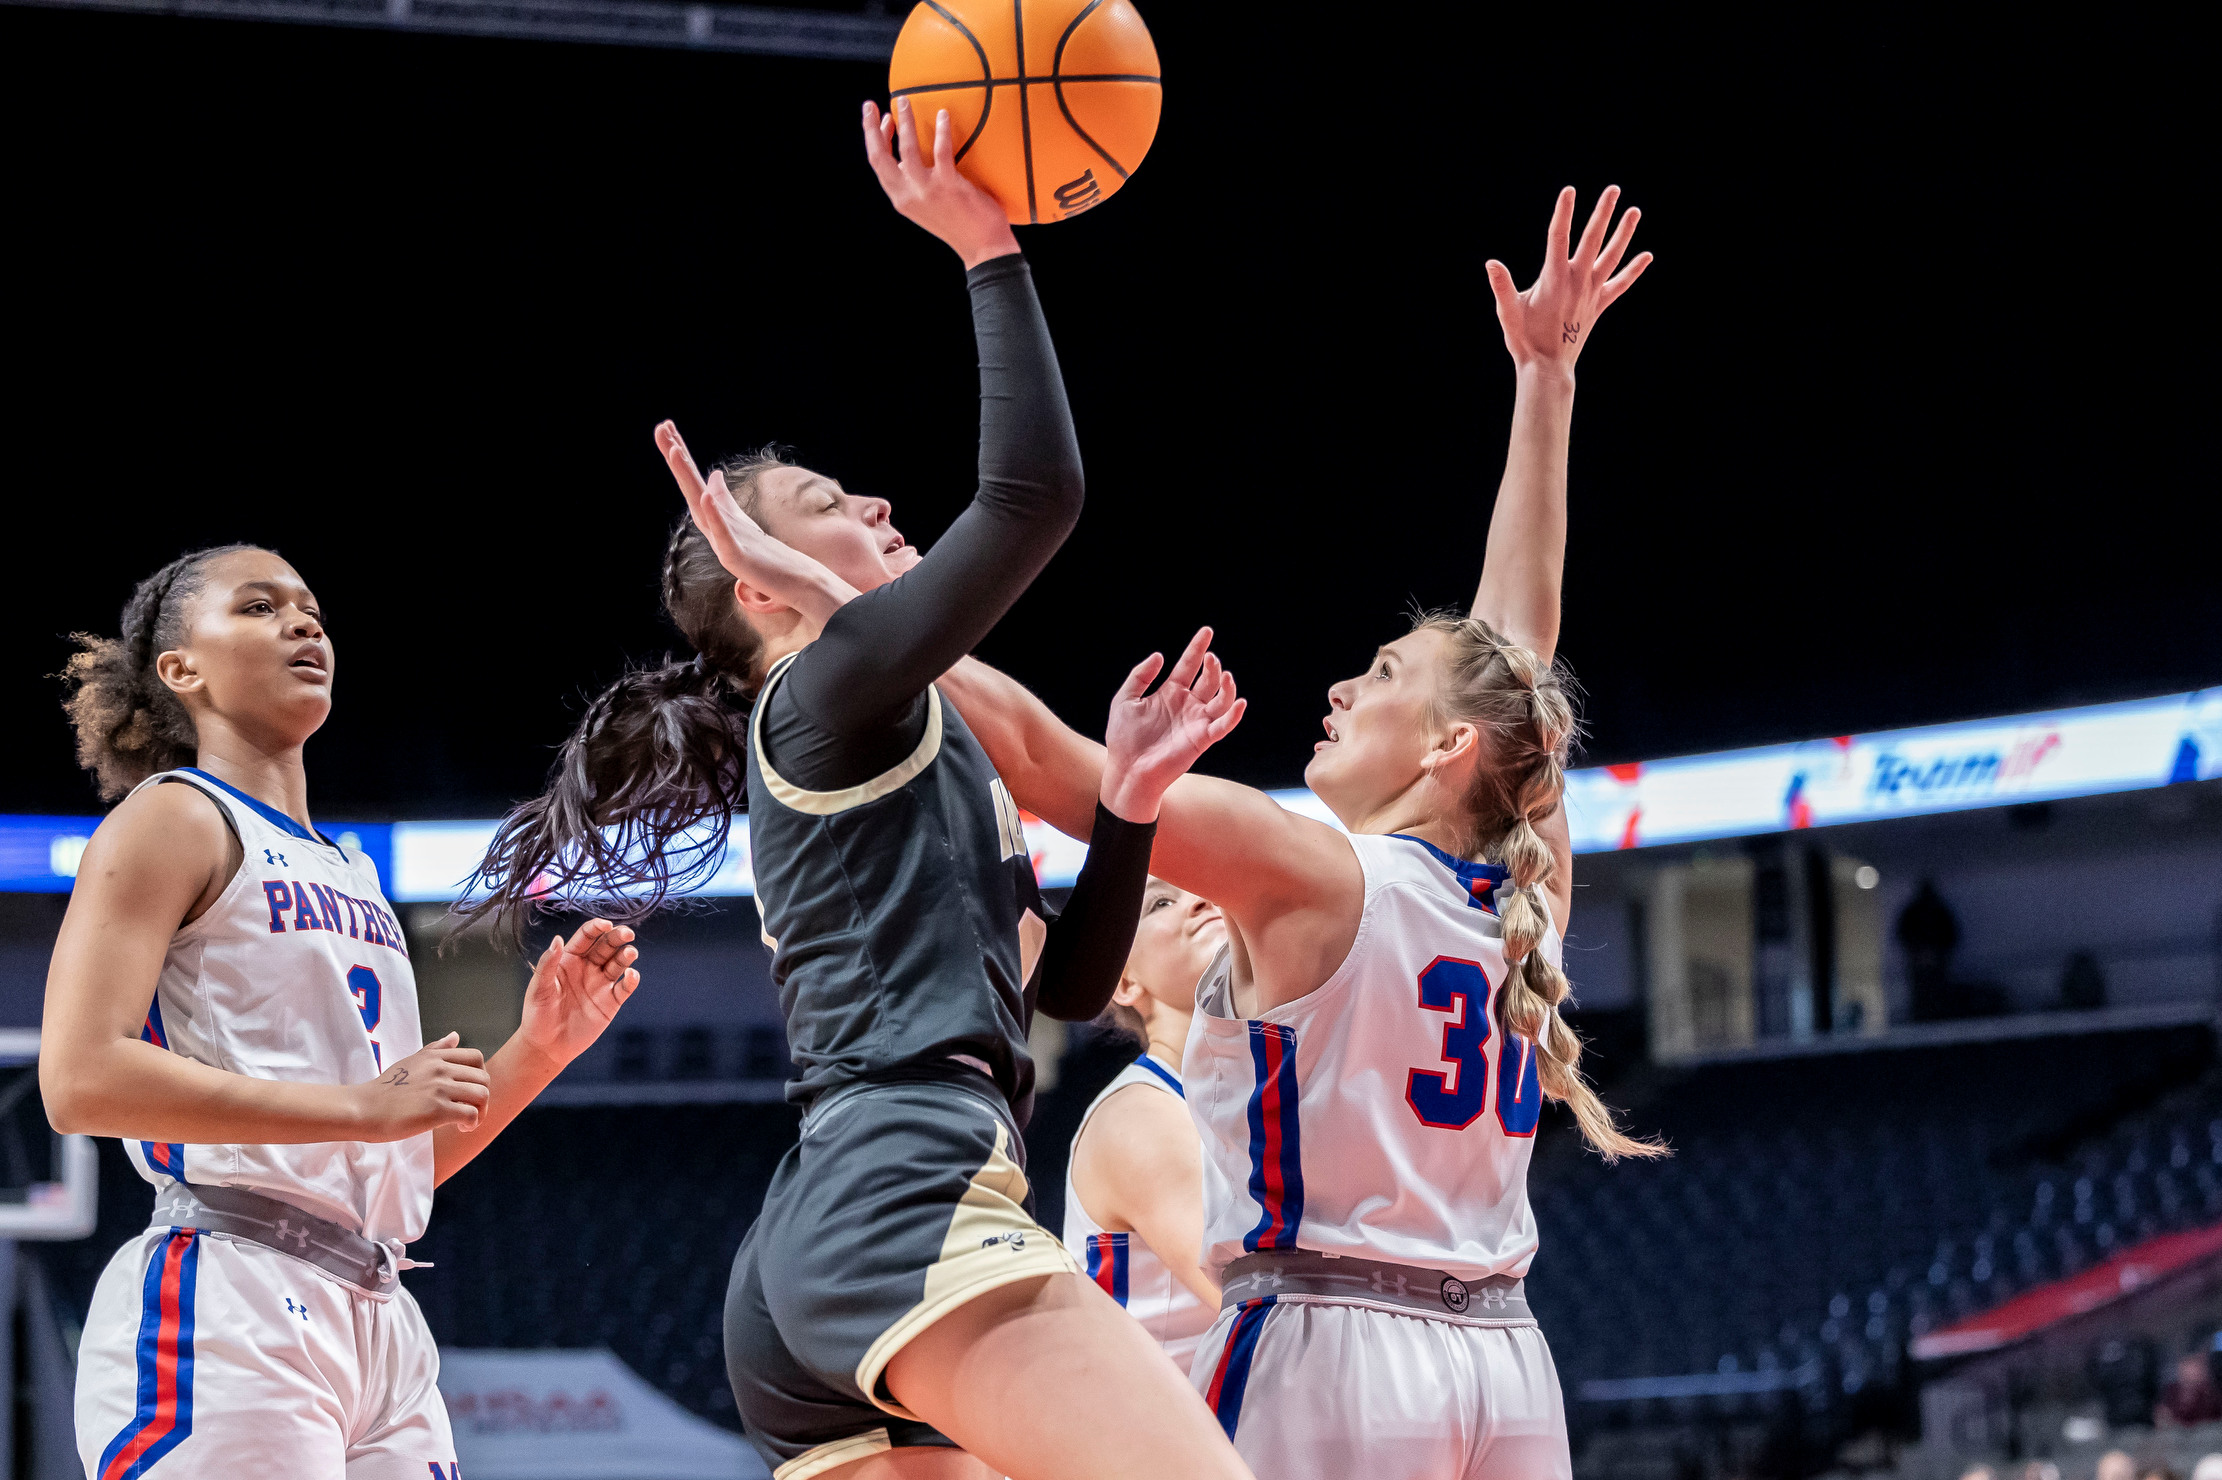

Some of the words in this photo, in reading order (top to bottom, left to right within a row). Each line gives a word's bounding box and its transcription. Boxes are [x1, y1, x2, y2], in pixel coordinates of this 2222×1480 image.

[1562, 322, 1581, 344] 32
[1405, 954, 1543, 1138] 30
[381, 1067, 410, 1087] 32
